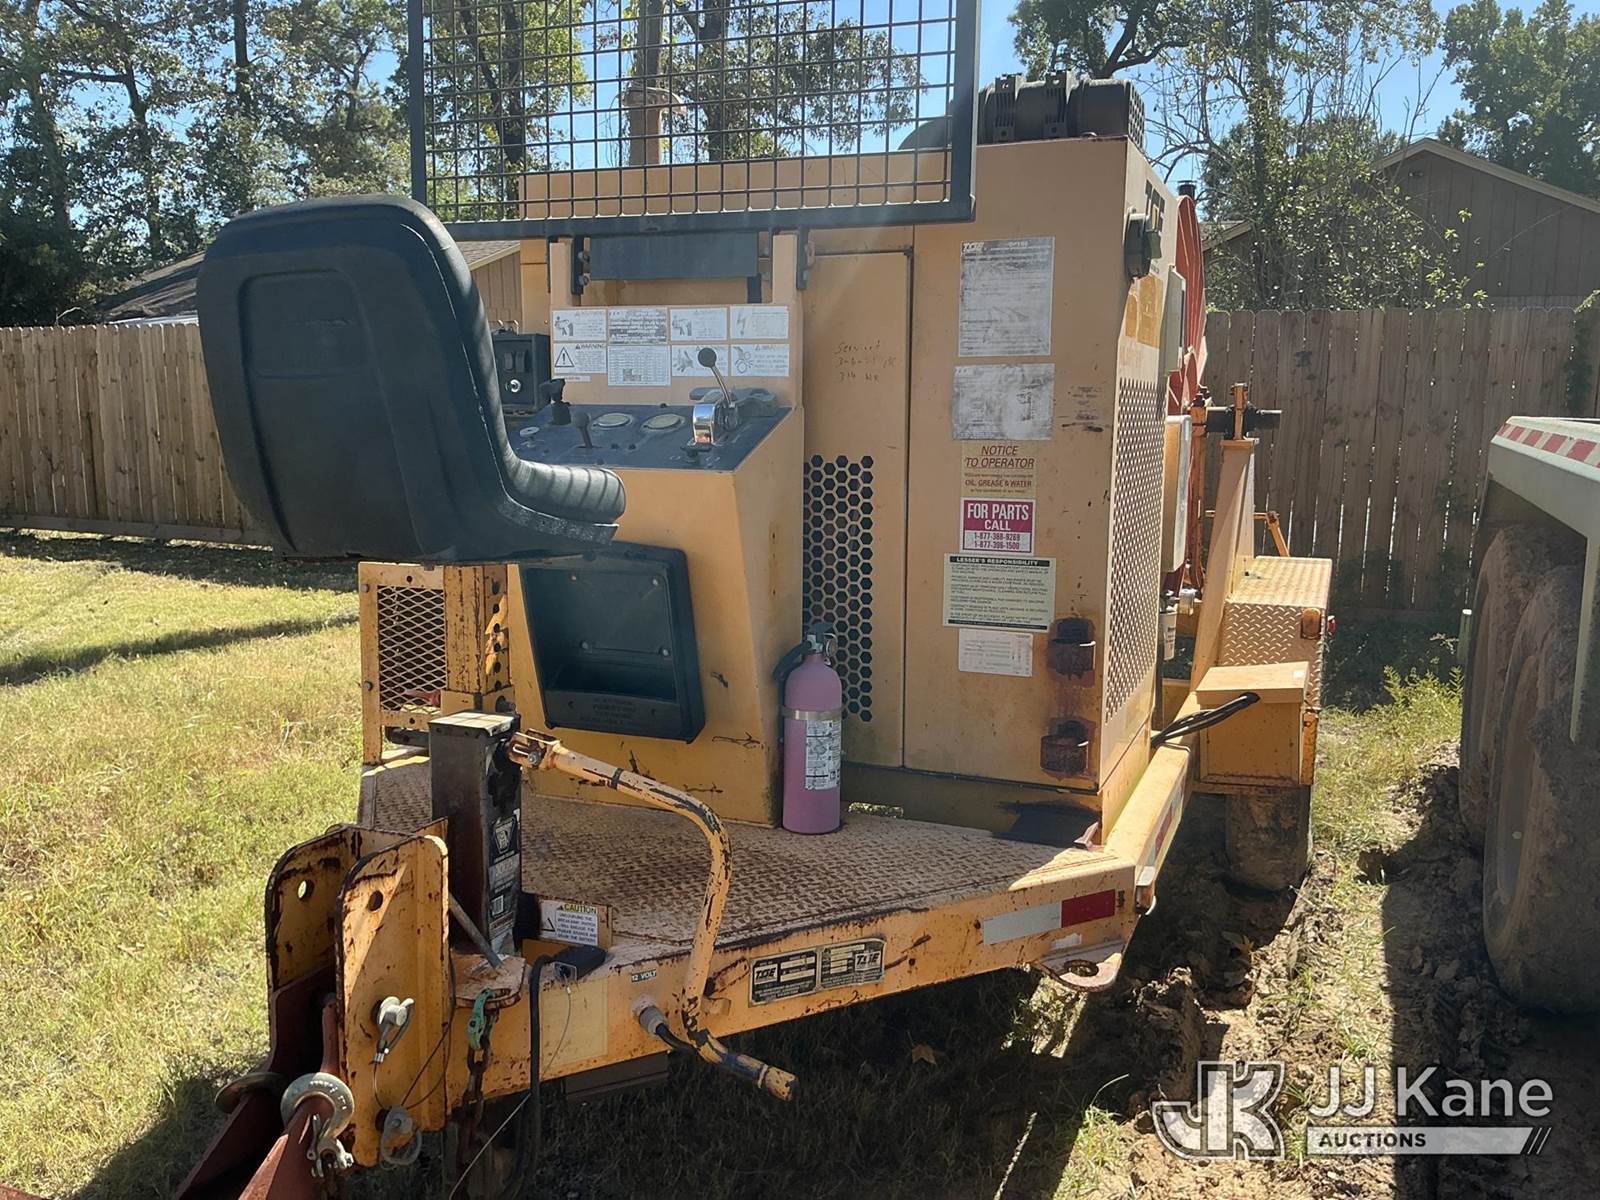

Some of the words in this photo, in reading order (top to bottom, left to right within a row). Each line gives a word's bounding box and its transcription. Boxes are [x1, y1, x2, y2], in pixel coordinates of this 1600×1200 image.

[981, 445, 1019, 456] NOTICE
[965, 457, 979, 468] TO
[981, 458, 1035, 469] OPERATOR
[978, 479, 1003, 487] GREASE
[1010, 480, 1032, 488] WATER
[967, 503, 989, 519] FOR
[992, 504, 1029, 521] PARTS
[984, 520, 1012, 531] CALL
[956, 556, 986, 564] LESSEE'S
[987, 558, 1038, 566] RESPONSIBILITY
[563, 903, 597, 914] CAUTION
[640, 970, 657, 979] VOLT
